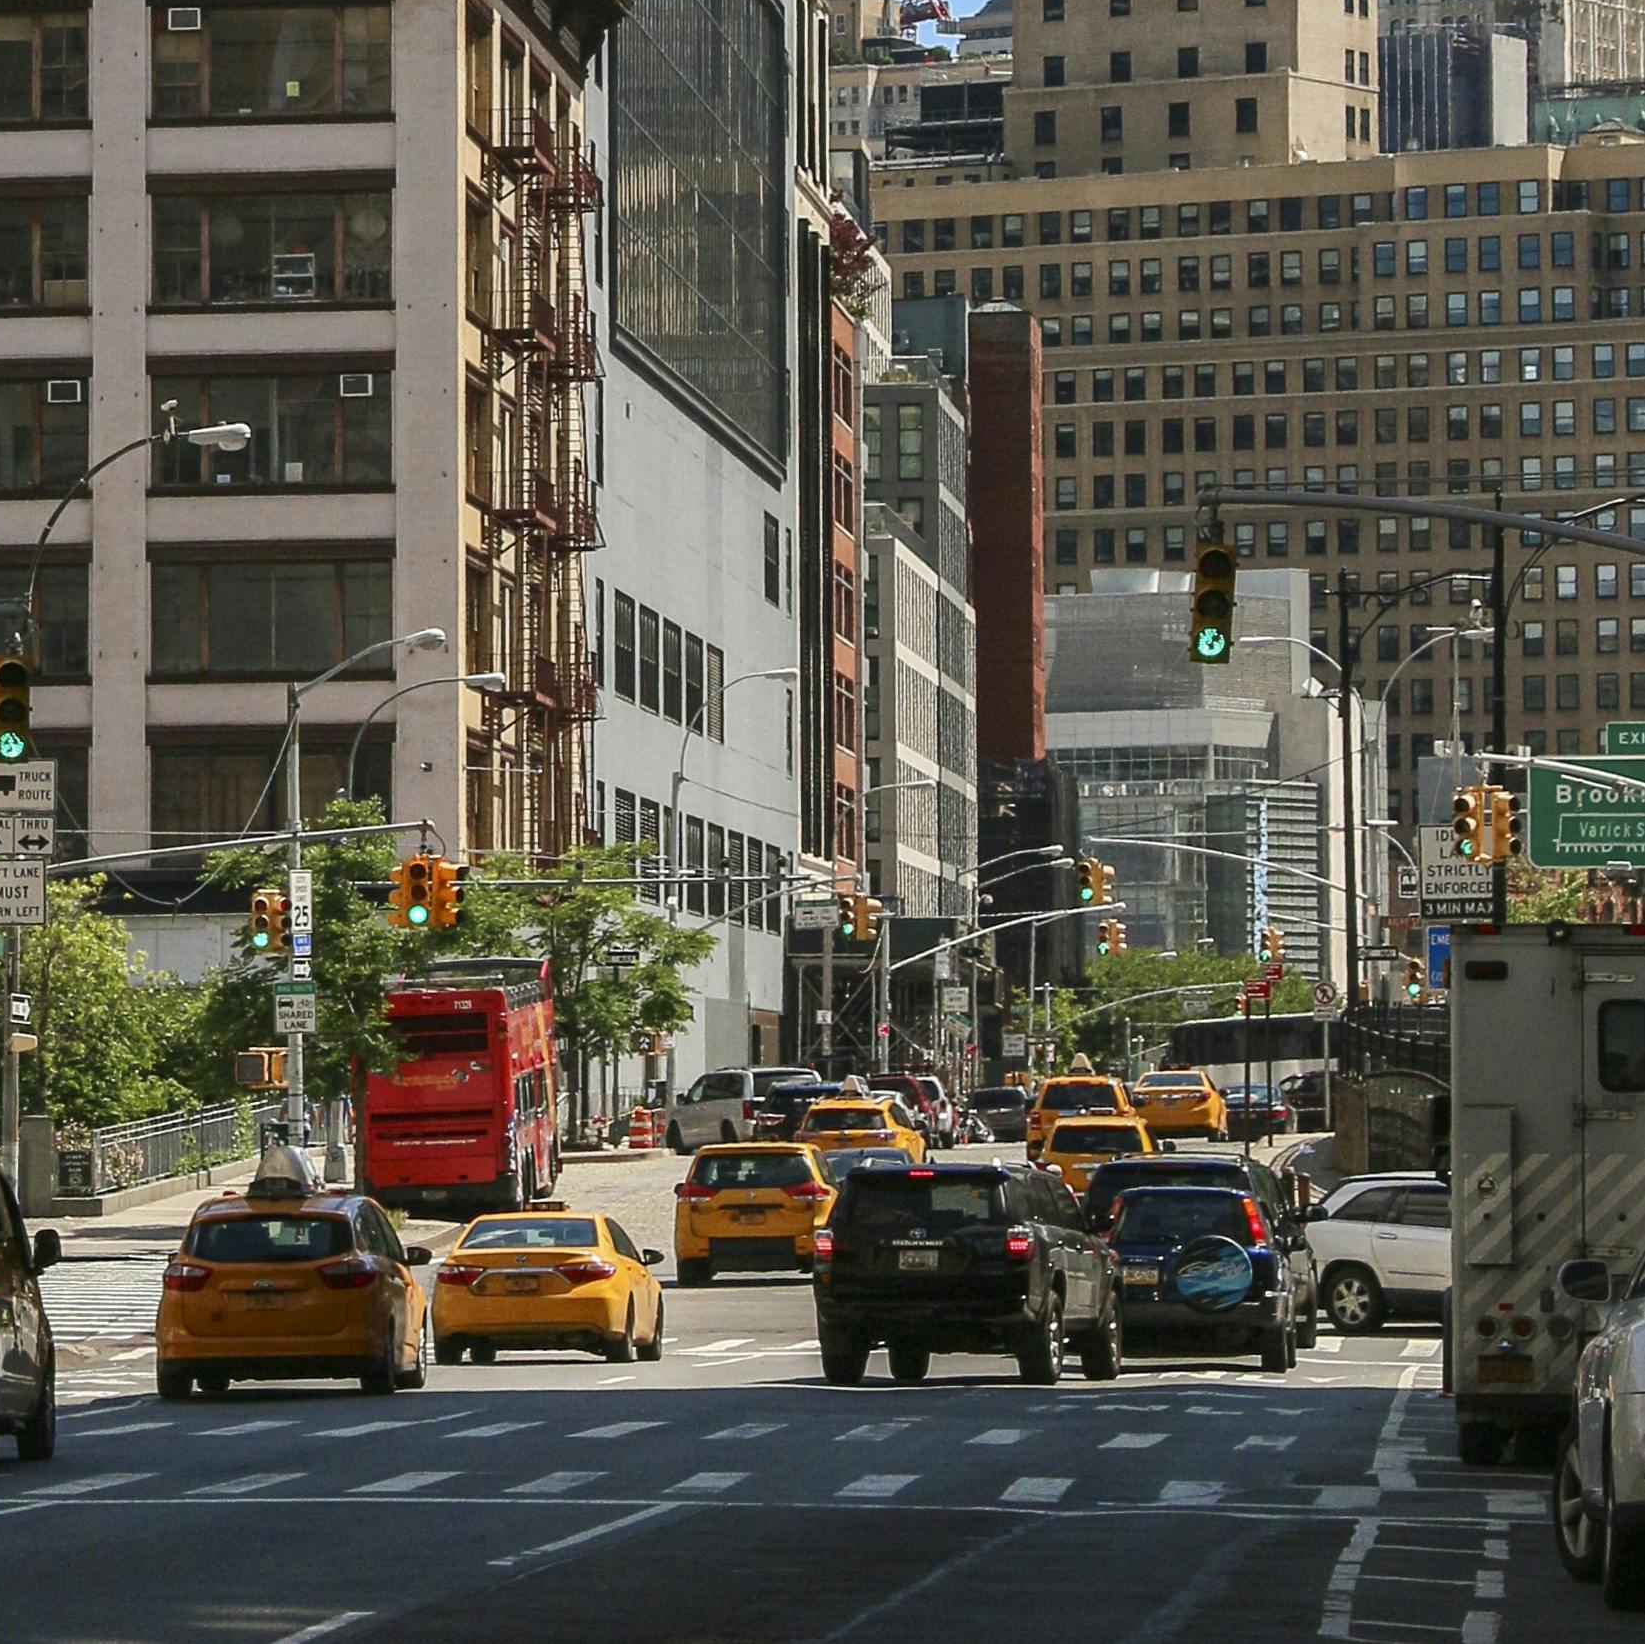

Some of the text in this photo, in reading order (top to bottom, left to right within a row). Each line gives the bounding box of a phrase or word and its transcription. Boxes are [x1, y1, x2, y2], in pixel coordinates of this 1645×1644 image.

[19, 771, 52, 782] TRUCK
[18, 789, 52, 801] ROUTE
[20, 819, 49, 830] THRU
[1579, 821, 1631, 838] Varick
[13, 867, 40, 879] LANE
[1427, 864, 1492, 877] STRICTLY
[1425, 881, 1493, 895] ENFORCED
[16, 906, 40, 917] LEFT
[1425, 902, 1493, 915] 3 MIN MAX
[294, 905, 309, 927] 25
[278, 1010, 314, 1019] SHARED
[284, 1021, 308, 1030] LANE
